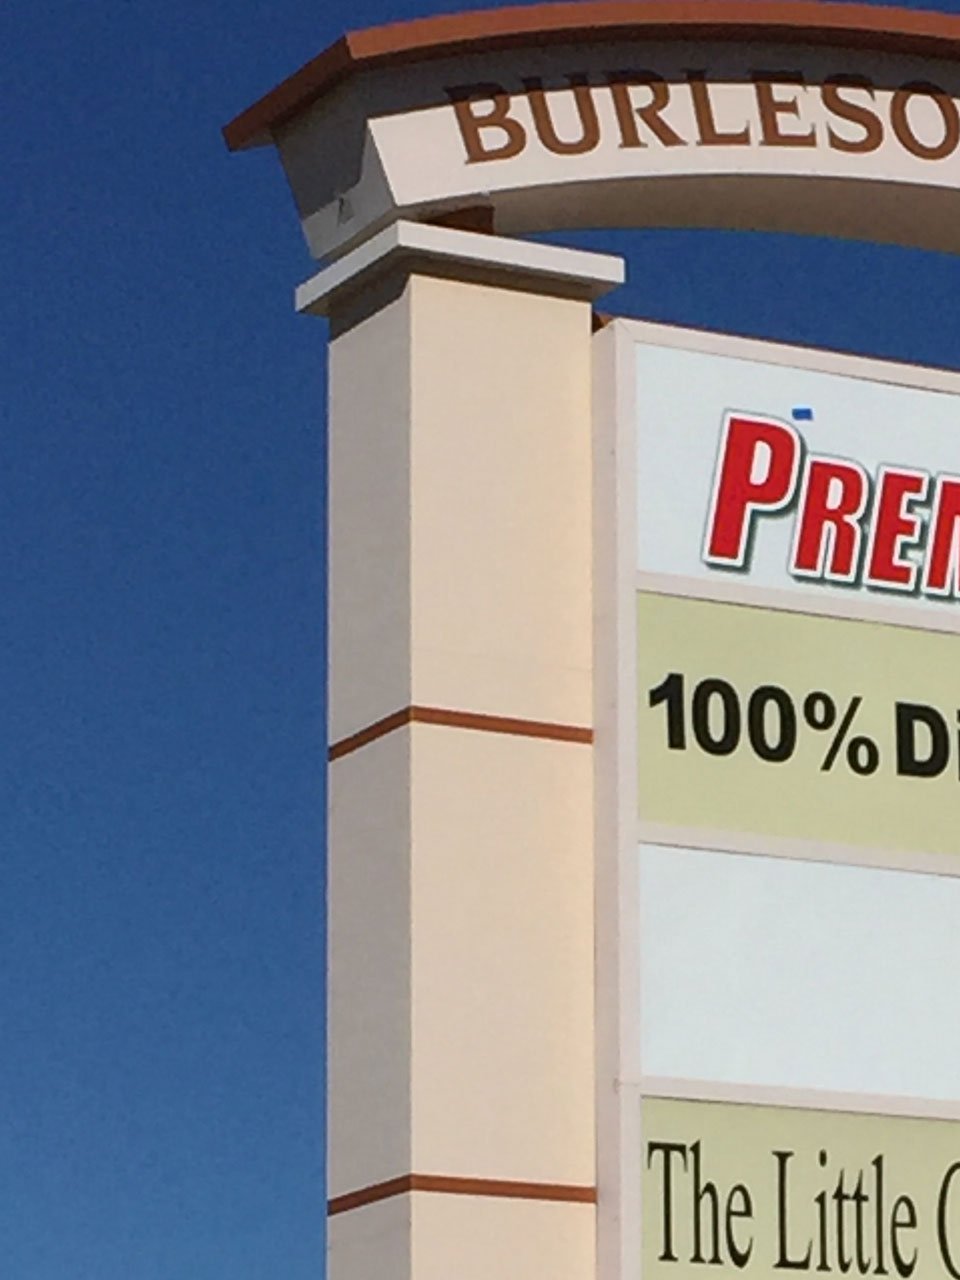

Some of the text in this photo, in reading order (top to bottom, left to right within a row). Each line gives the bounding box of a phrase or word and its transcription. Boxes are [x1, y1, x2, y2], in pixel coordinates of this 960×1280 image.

[648, 672, 880, 776] 100%
[648, 1140, 754, 1269] The
[772, 1149, 918, 1279] Little
